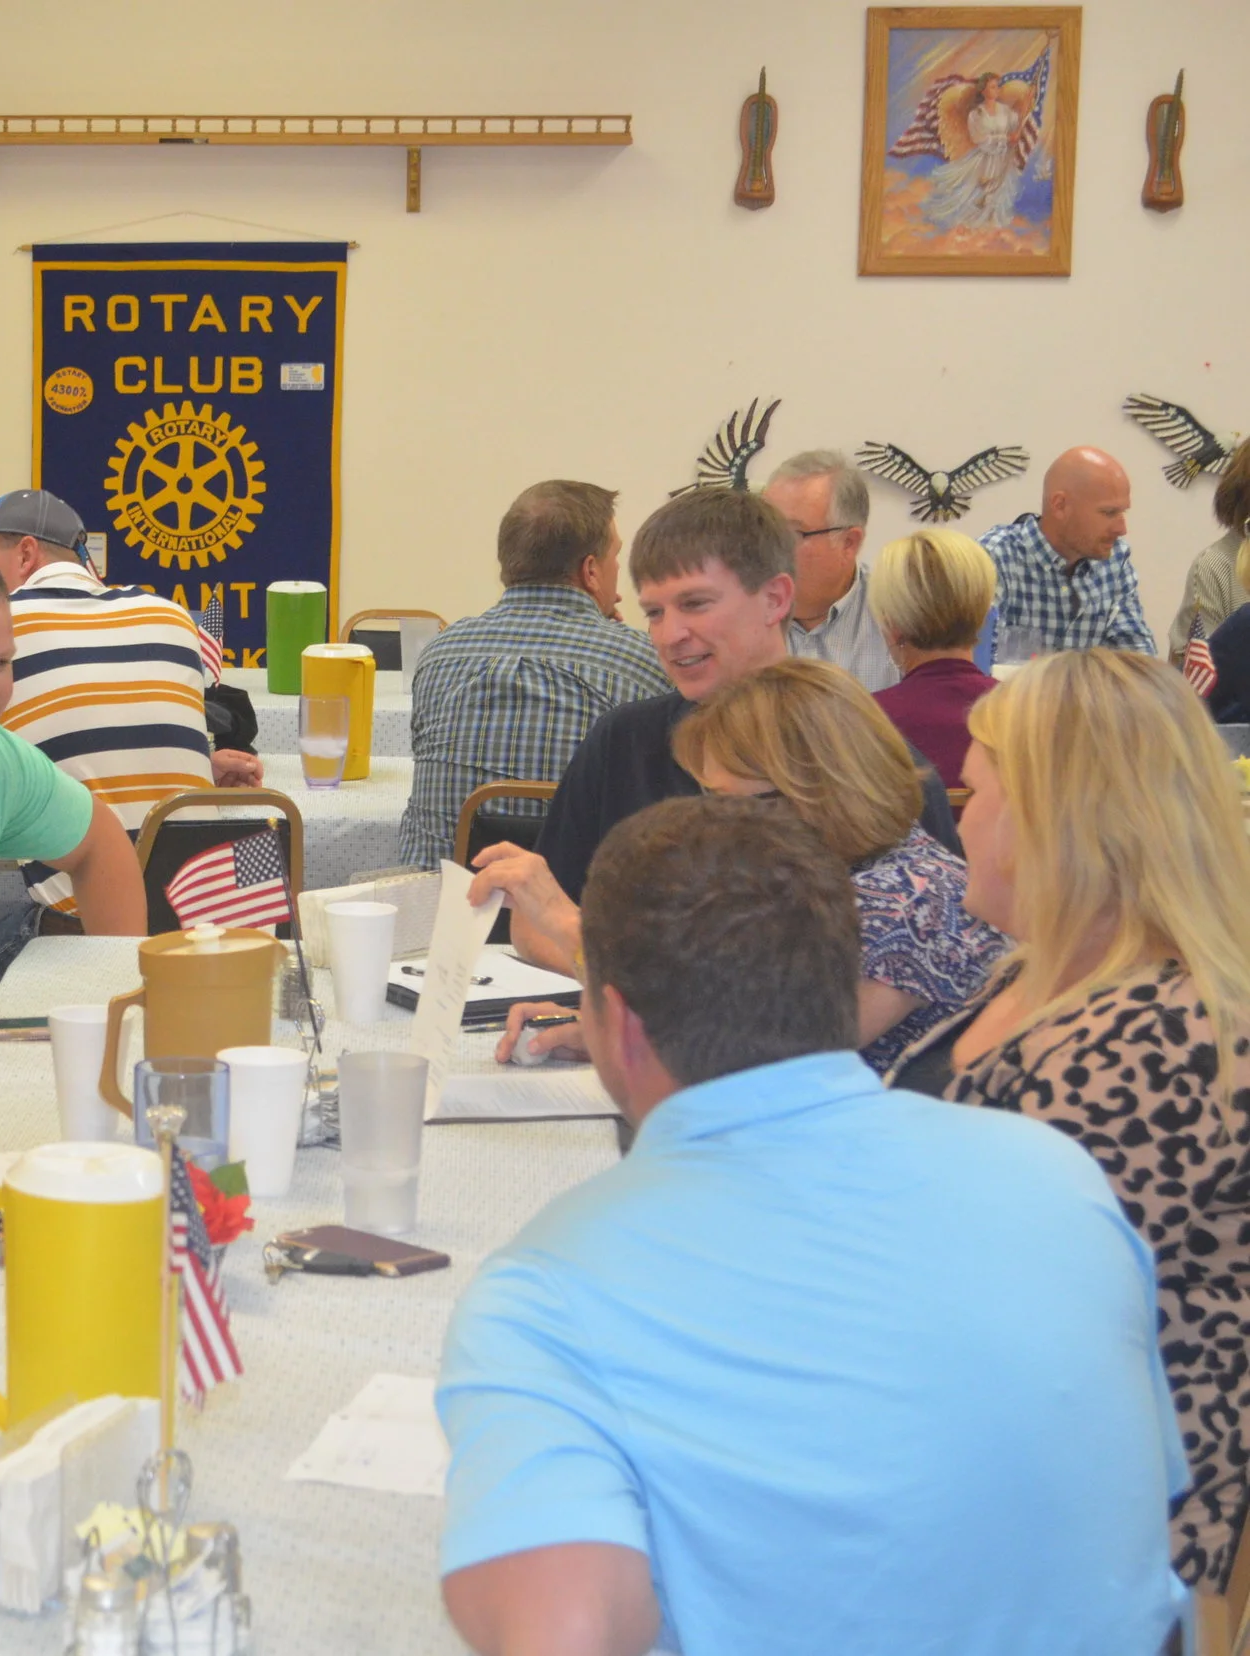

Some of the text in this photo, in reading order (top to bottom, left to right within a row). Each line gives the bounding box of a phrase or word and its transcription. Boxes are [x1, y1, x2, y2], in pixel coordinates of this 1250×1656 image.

[63, 294, 323, 333] ROTARY
[55, 369, 88, 379] ROTARY
[114, 355, 264, 394] CLUB
[149, 419, 228, 446] ROTARY
[126, 502, 243, 551] INTERNATIONAL
[108, 582, 256, 619] ANT
